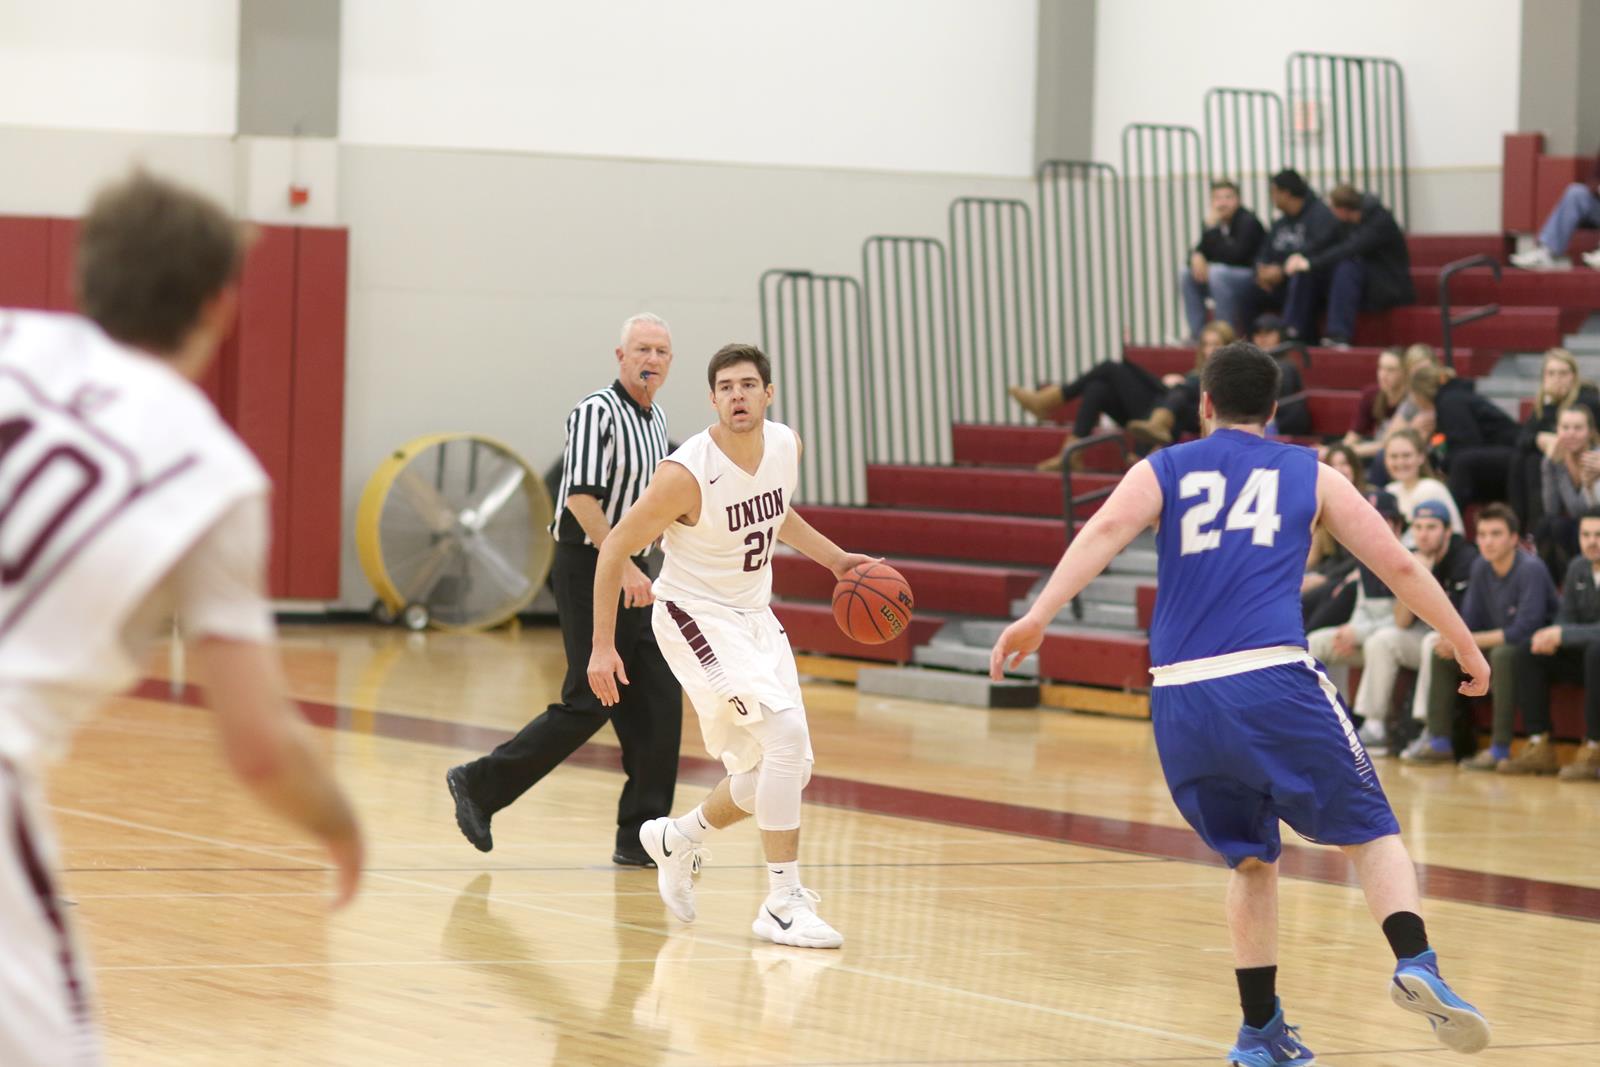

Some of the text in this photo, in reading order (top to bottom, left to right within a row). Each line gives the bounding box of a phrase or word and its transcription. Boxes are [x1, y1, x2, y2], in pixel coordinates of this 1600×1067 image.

[726, 487, 784, 532] UNION
[1179, 468, 1281, 557] 24
[743, 527, 773, 572] 21
